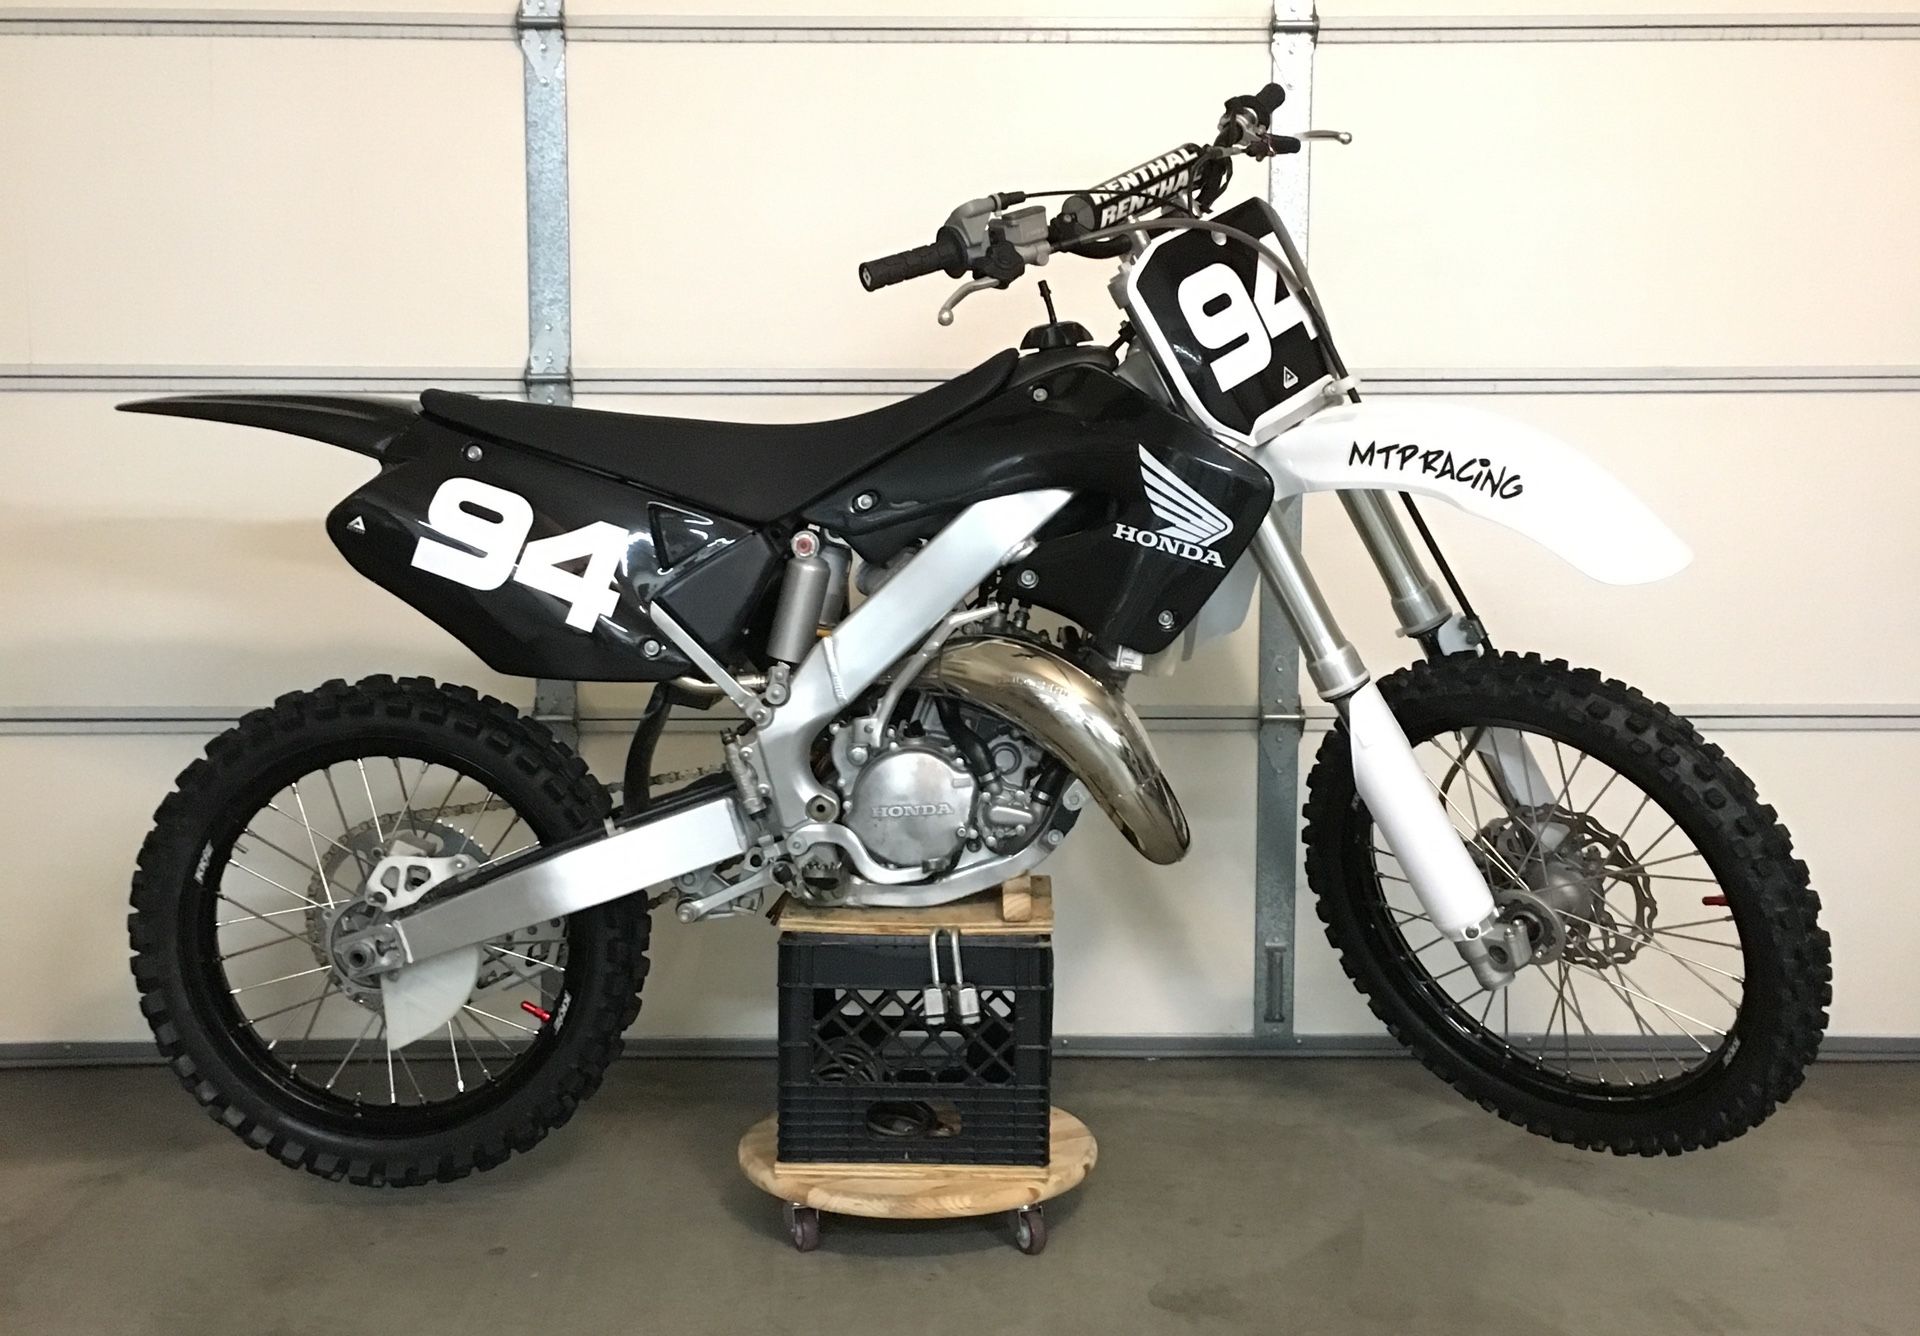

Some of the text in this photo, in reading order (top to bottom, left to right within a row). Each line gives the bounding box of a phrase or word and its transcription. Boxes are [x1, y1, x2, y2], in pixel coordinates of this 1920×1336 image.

[1090, 149, 1198, 205] RENTHAL
[1178, 231, 1319, 393] 94
[411, 477, 629, 633] 94
[1112, 523, 1226, 568] HONDA
[871, 803, 955, 819] HONDA
